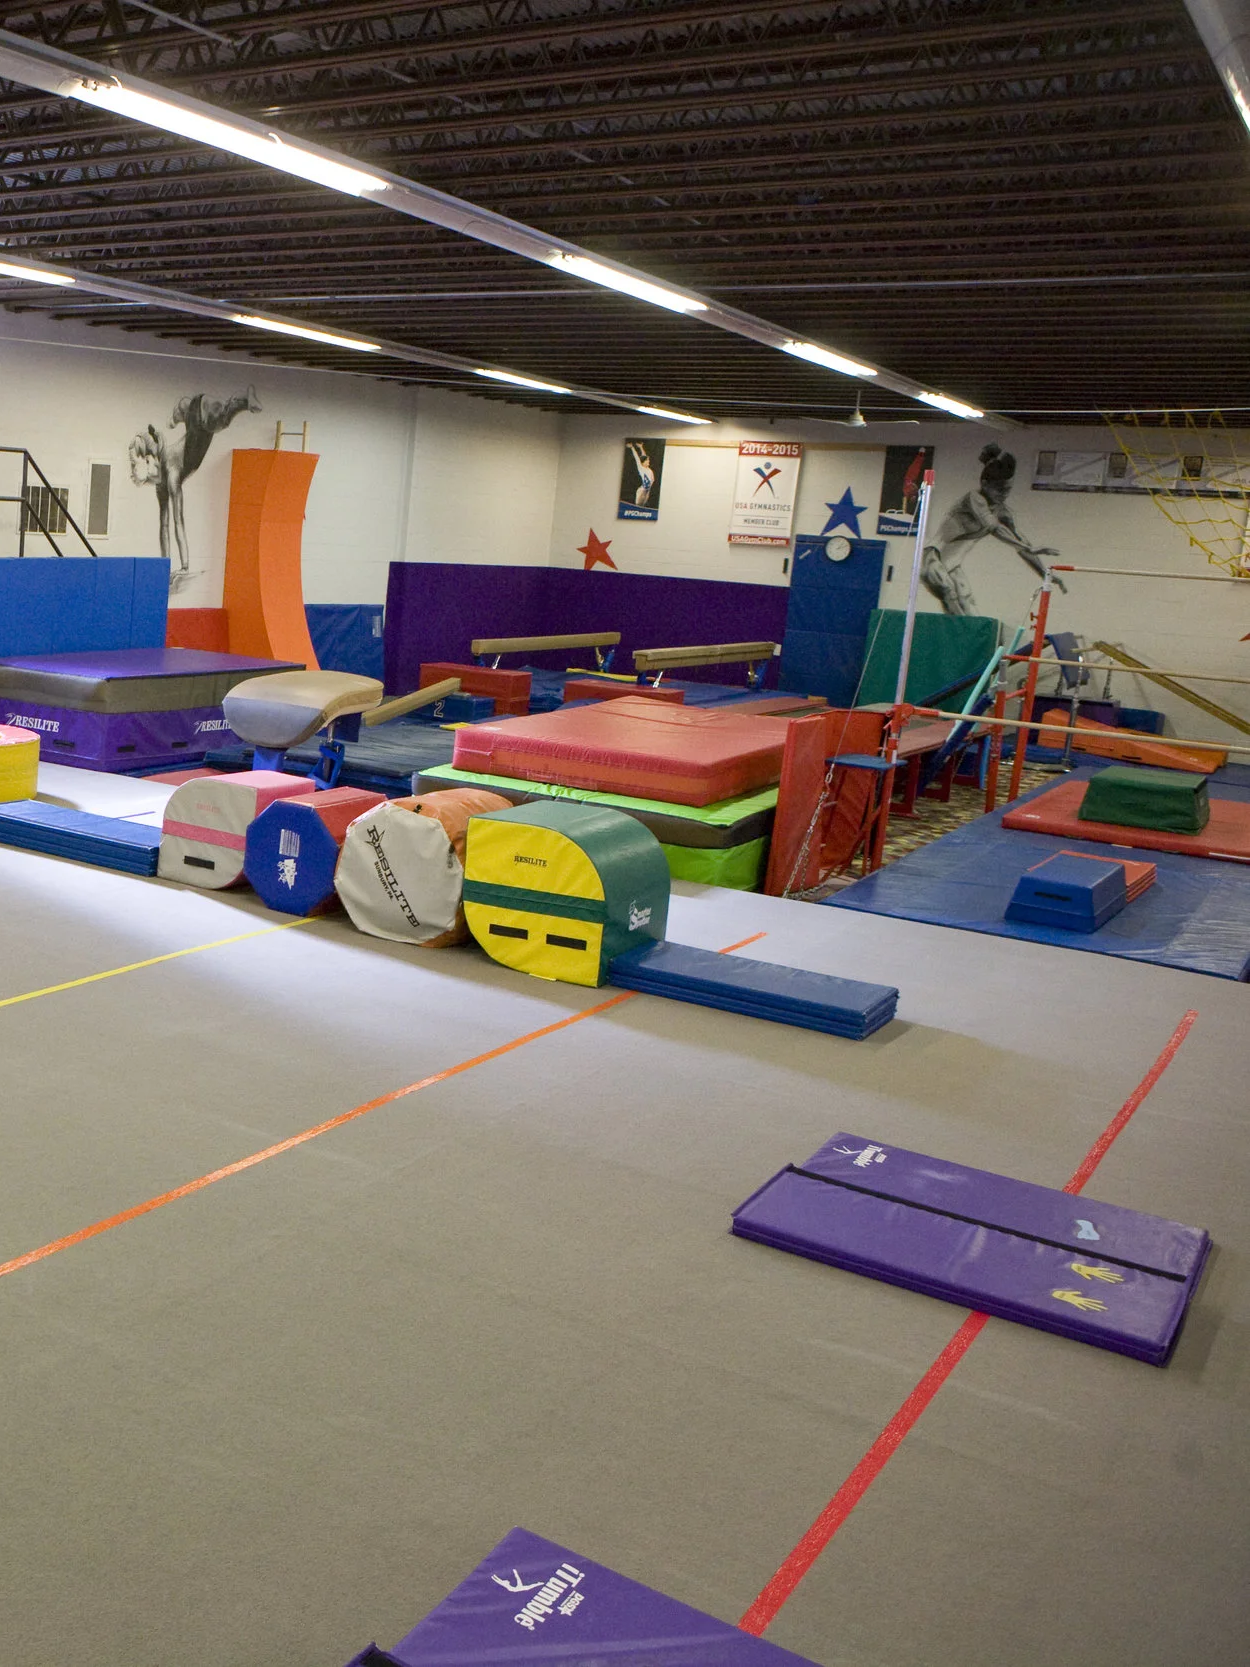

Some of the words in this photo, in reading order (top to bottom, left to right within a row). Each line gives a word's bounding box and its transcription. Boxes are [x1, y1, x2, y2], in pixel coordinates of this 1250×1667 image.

[741, 443, 799, 455] 2014-2015
[749, 503, 791, 512] GYMNASTICS
[433, 699, 446, 718] 2
[14, 714, 60, 733] RESILITE
[200, 719, 232, 732] RESILIT
[513, 855, 548, 868] RESILITE
[364, 825, 421, 928] RESILITE
[513, 1562, 586, 1629] iTumble
